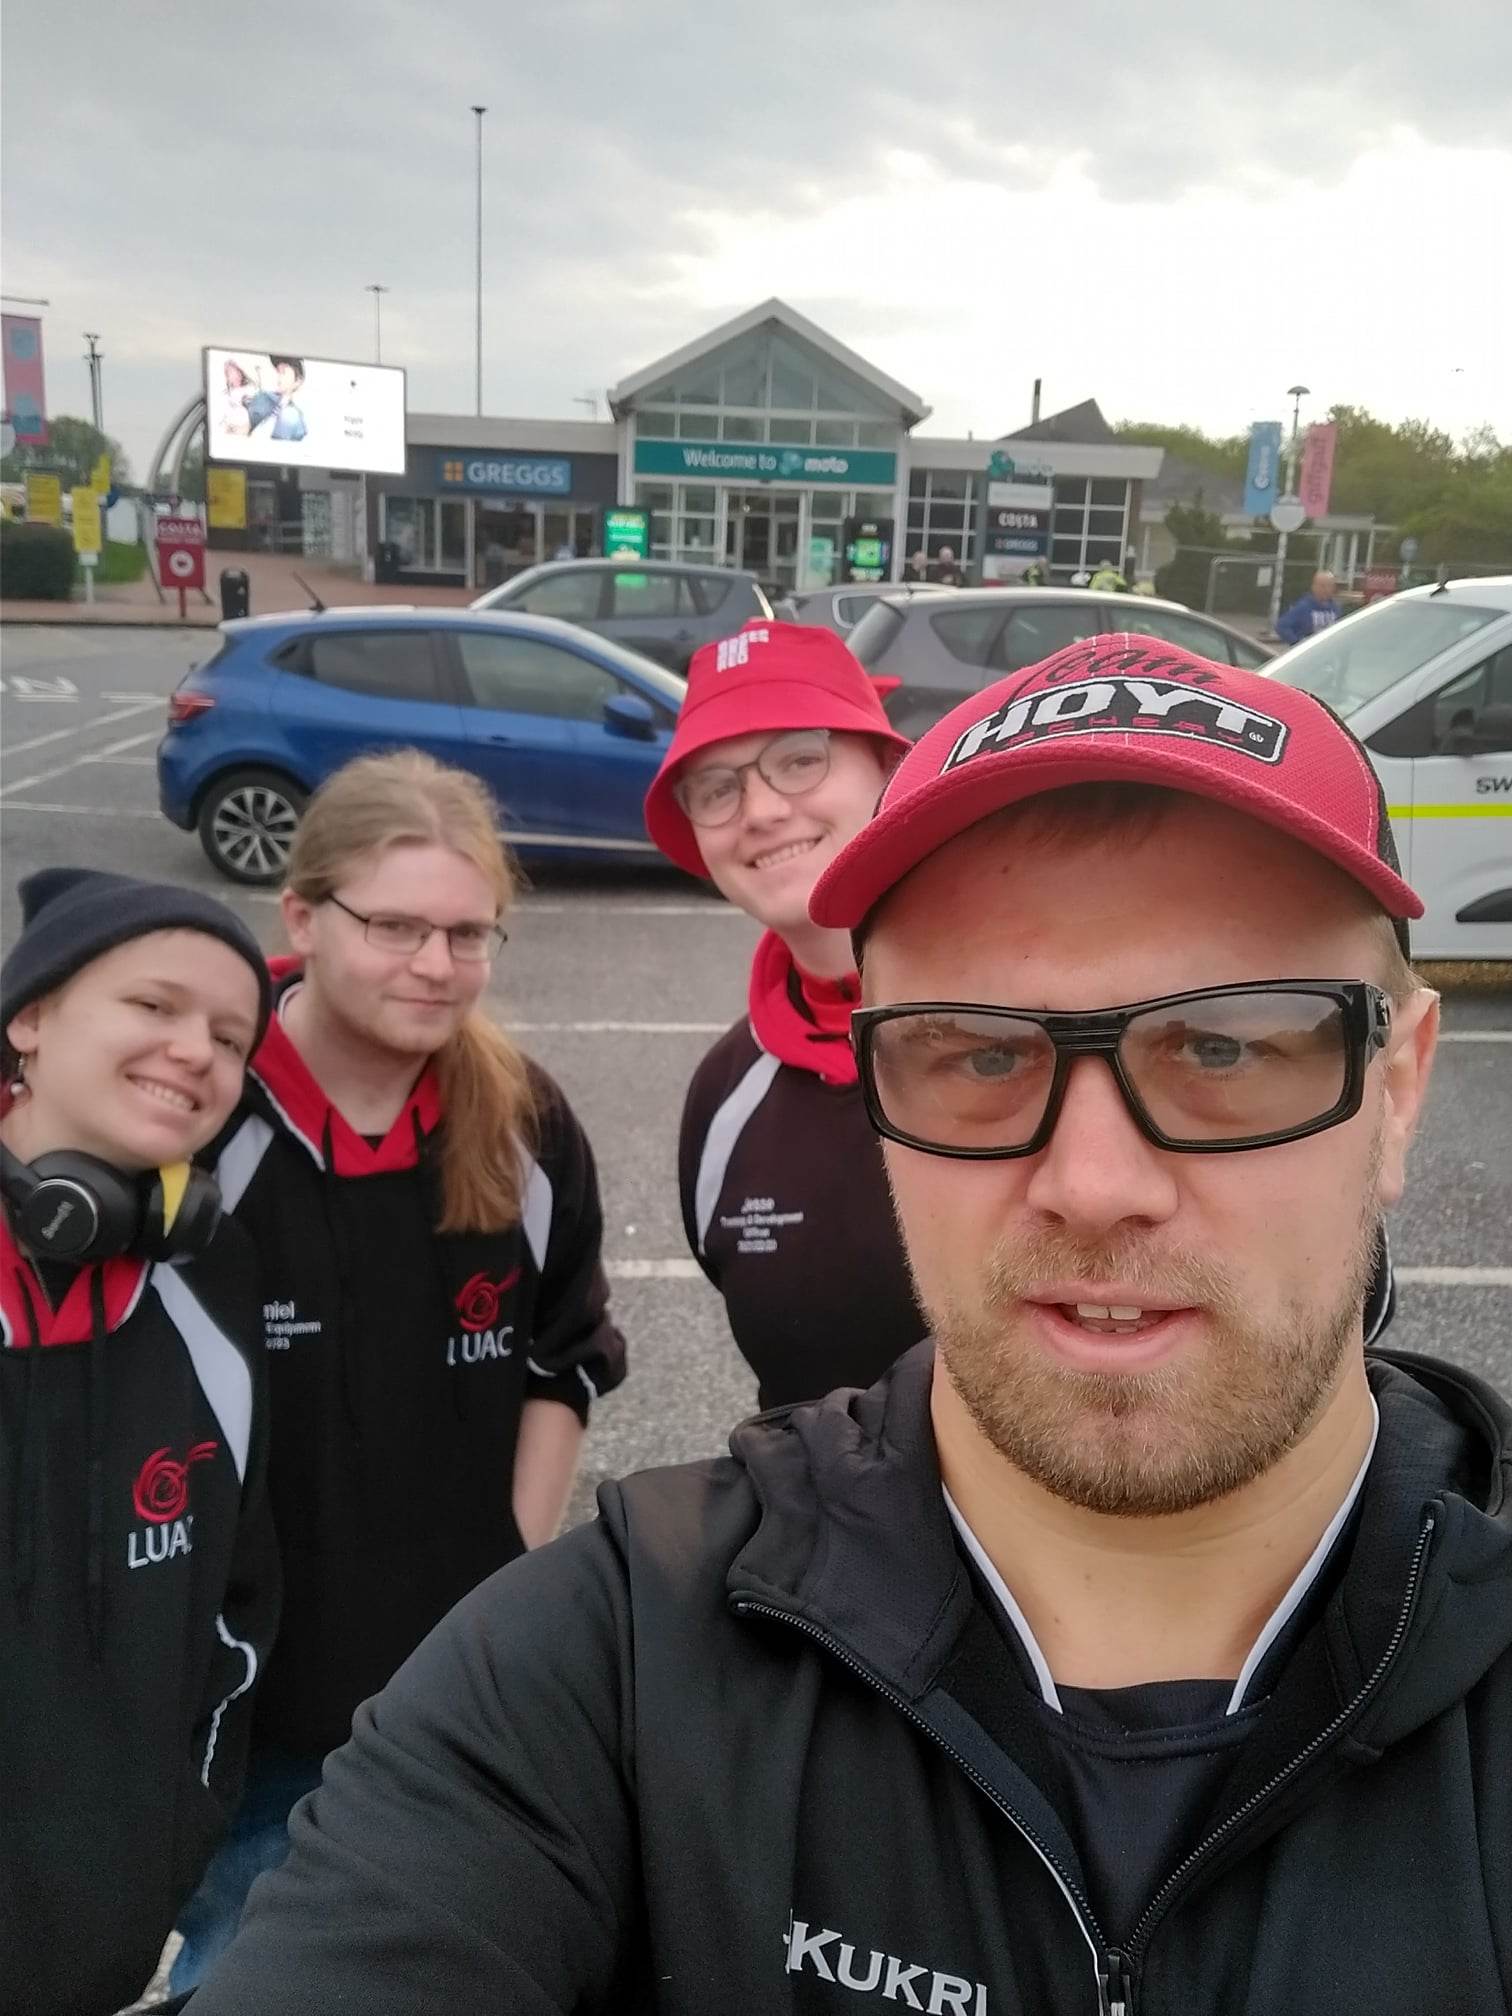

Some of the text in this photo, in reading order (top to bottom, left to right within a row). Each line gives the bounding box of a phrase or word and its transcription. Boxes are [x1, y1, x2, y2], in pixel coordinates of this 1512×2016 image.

[467, 462, 564, 486] GREGGS
[683, 449, 756, 470] Welcome
[759, 453, 777, 470] to
[956, 682, 1273, 762] HOYT
[127, 1514, 195, 1569] LUA
[783, 1915, 988, 2016] KUKRI
